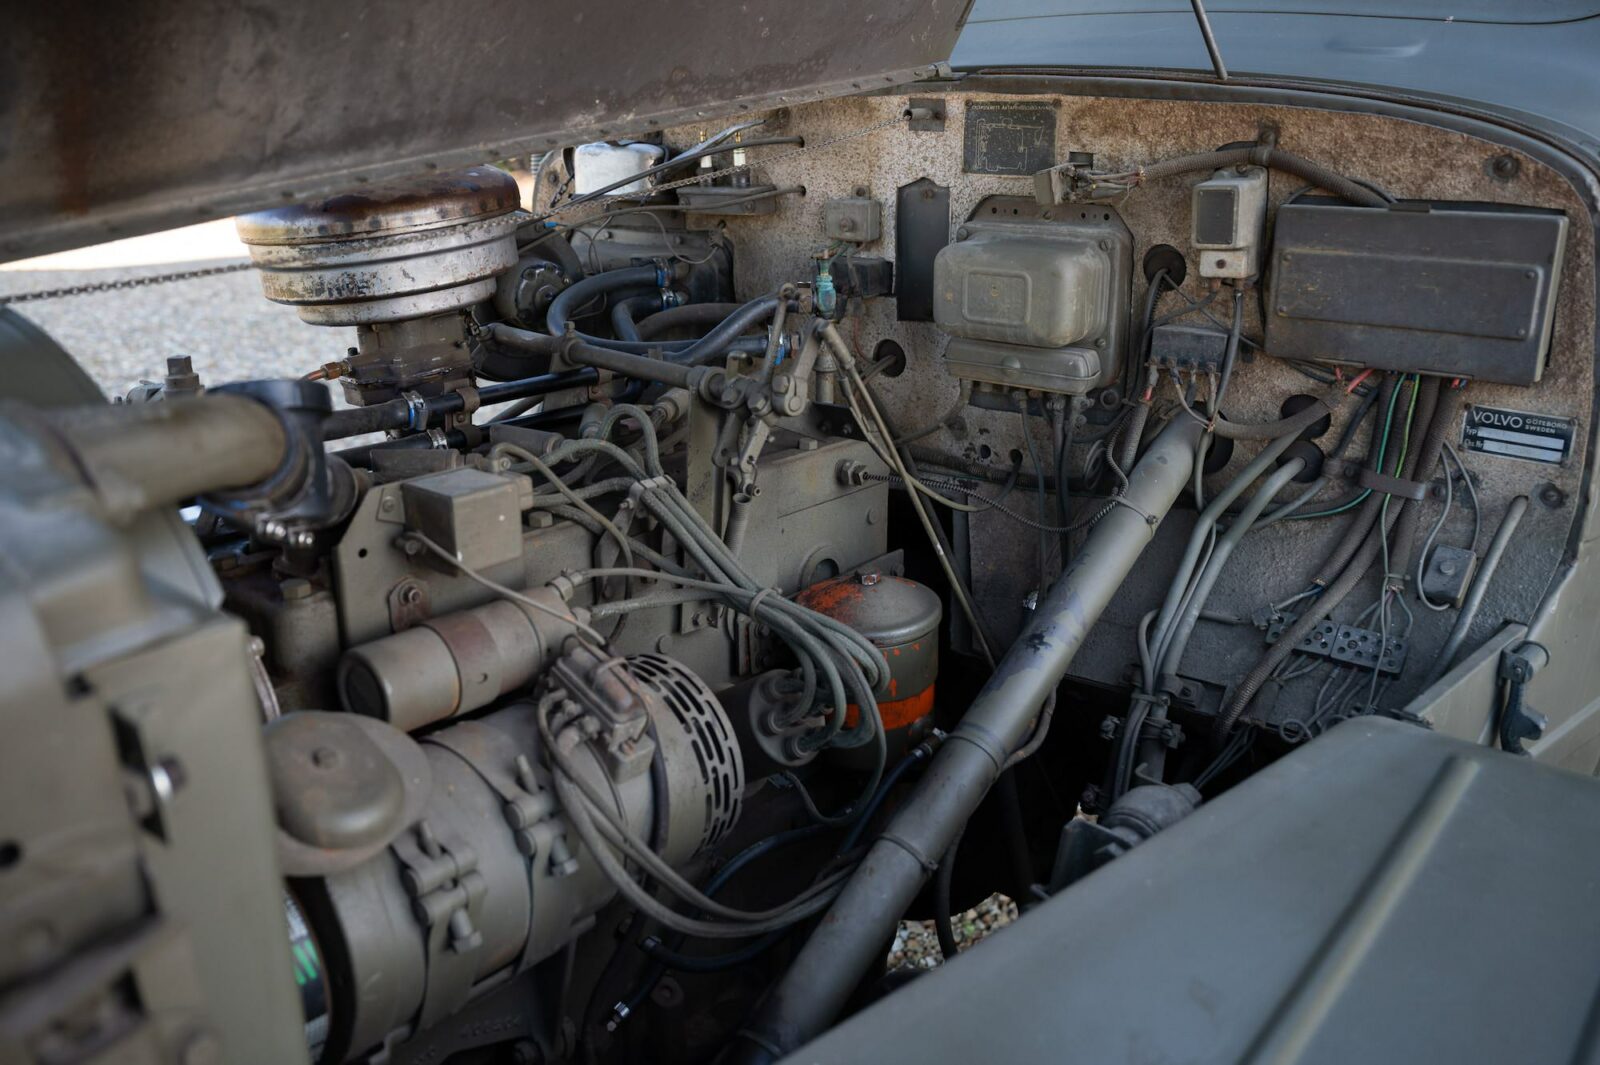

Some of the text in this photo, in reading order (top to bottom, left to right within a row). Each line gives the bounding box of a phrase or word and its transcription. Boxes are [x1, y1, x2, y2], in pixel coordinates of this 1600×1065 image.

[1473, 411, 1523, 428] VOLVO
[1525, 418, 1568, 430] GÖTEBORG
[1525, 425, 1556, 434] SWEDEN
